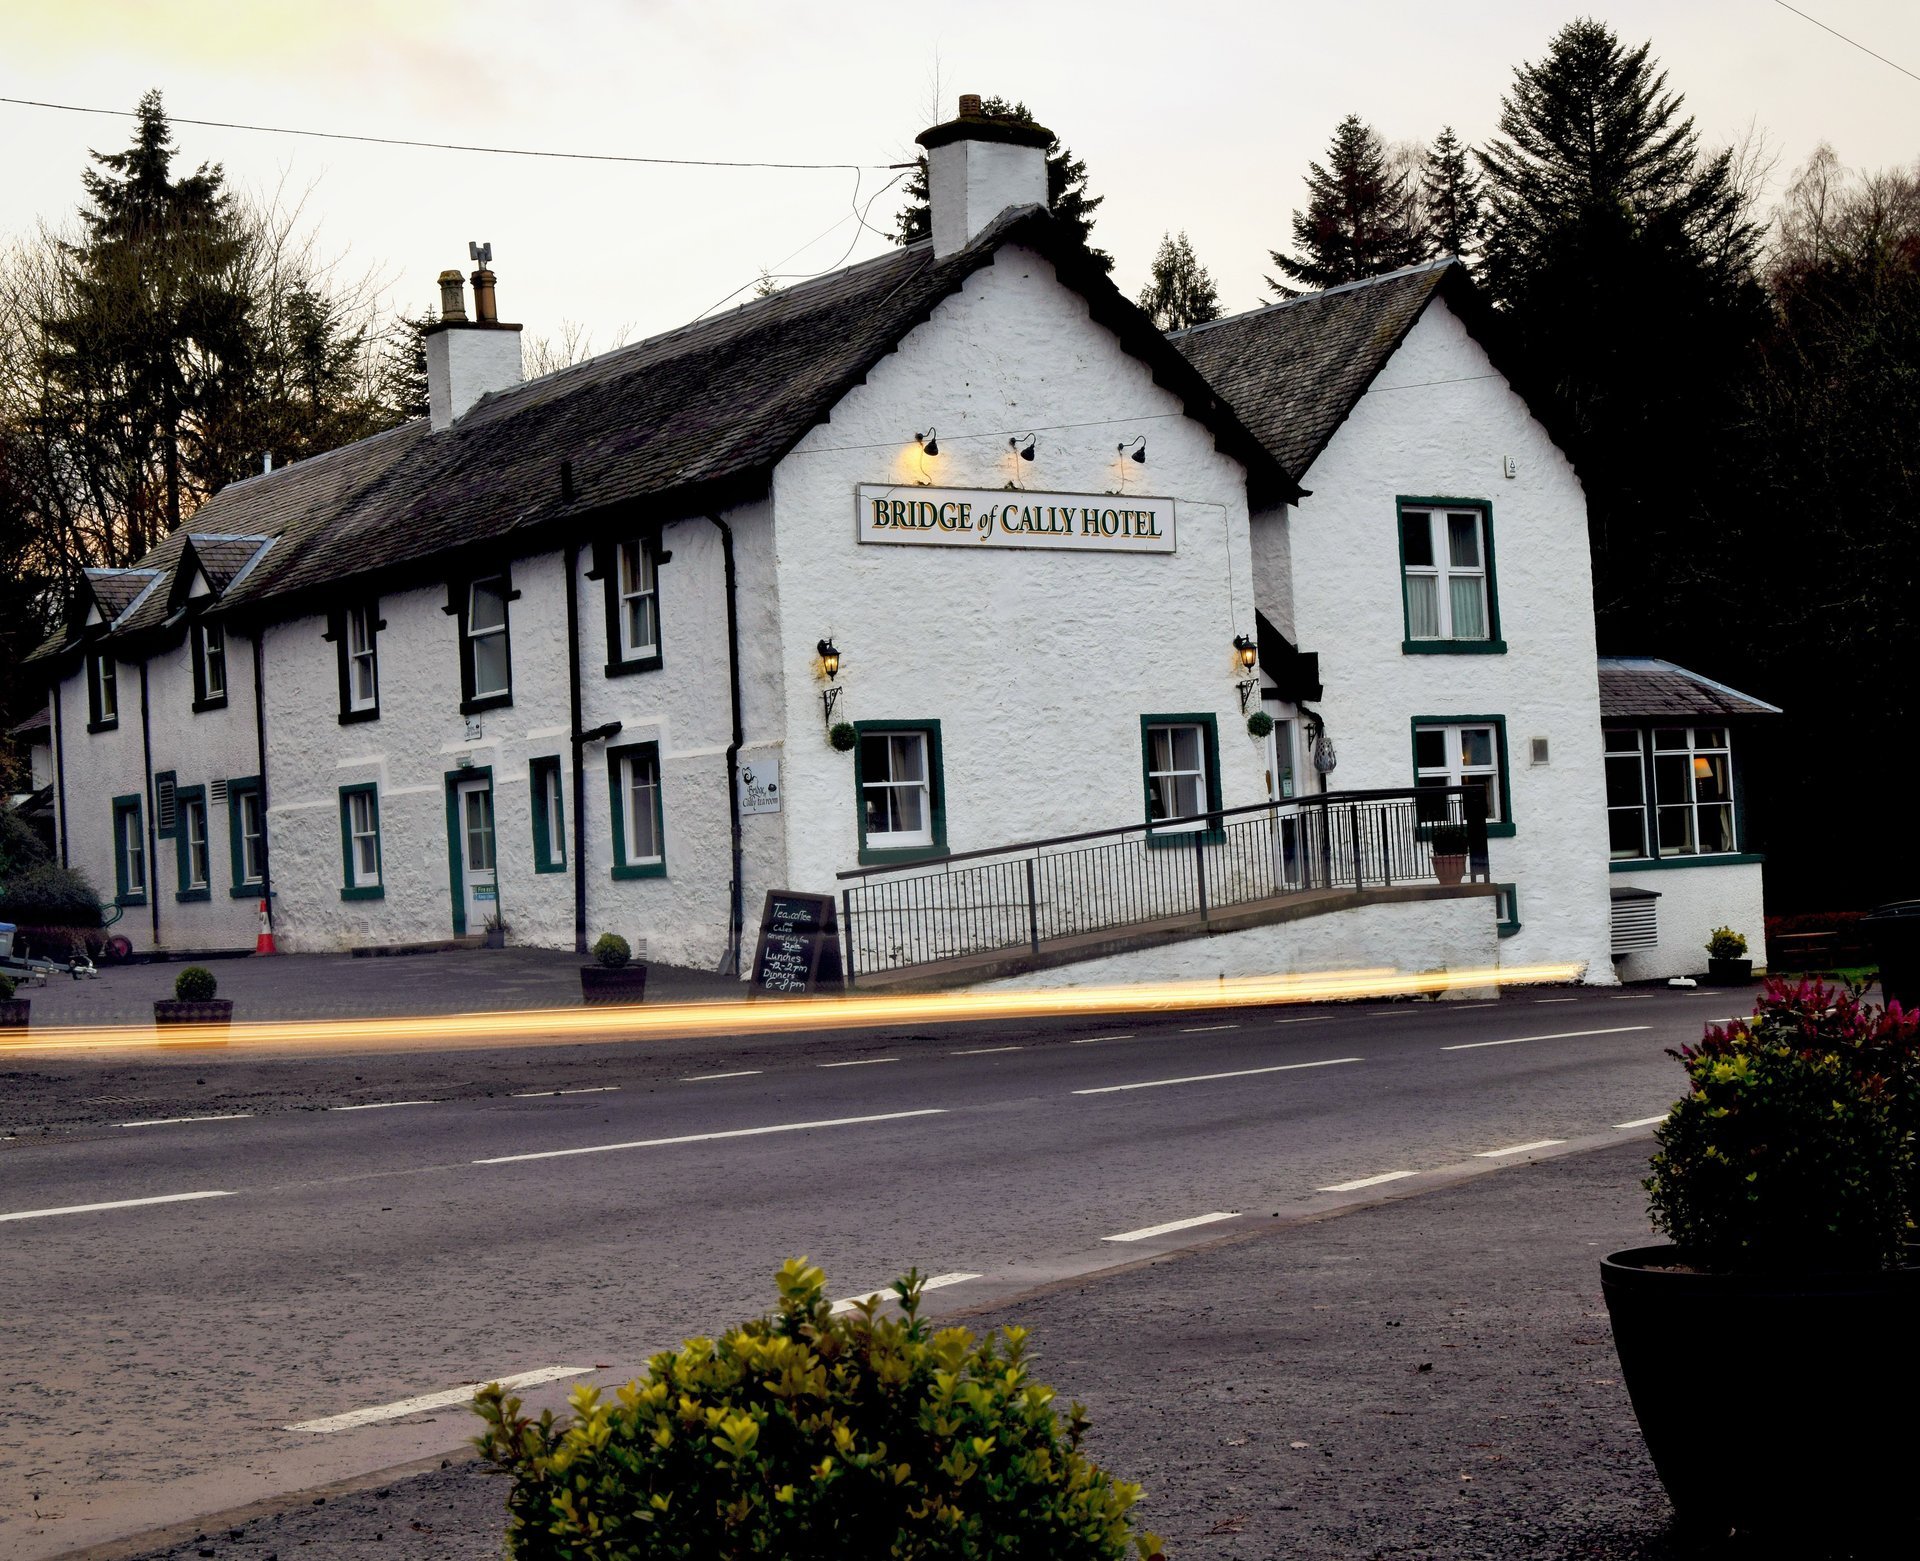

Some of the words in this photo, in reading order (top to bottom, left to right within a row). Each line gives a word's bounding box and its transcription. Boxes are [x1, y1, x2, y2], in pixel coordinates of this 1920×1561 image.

[872, 500, 973, 531] BRIDGE
[977, 505, 998, 541] of
[1000, 505, 1077, 536] CALLY
[1080, 508, 1163, 539] HOTEL
